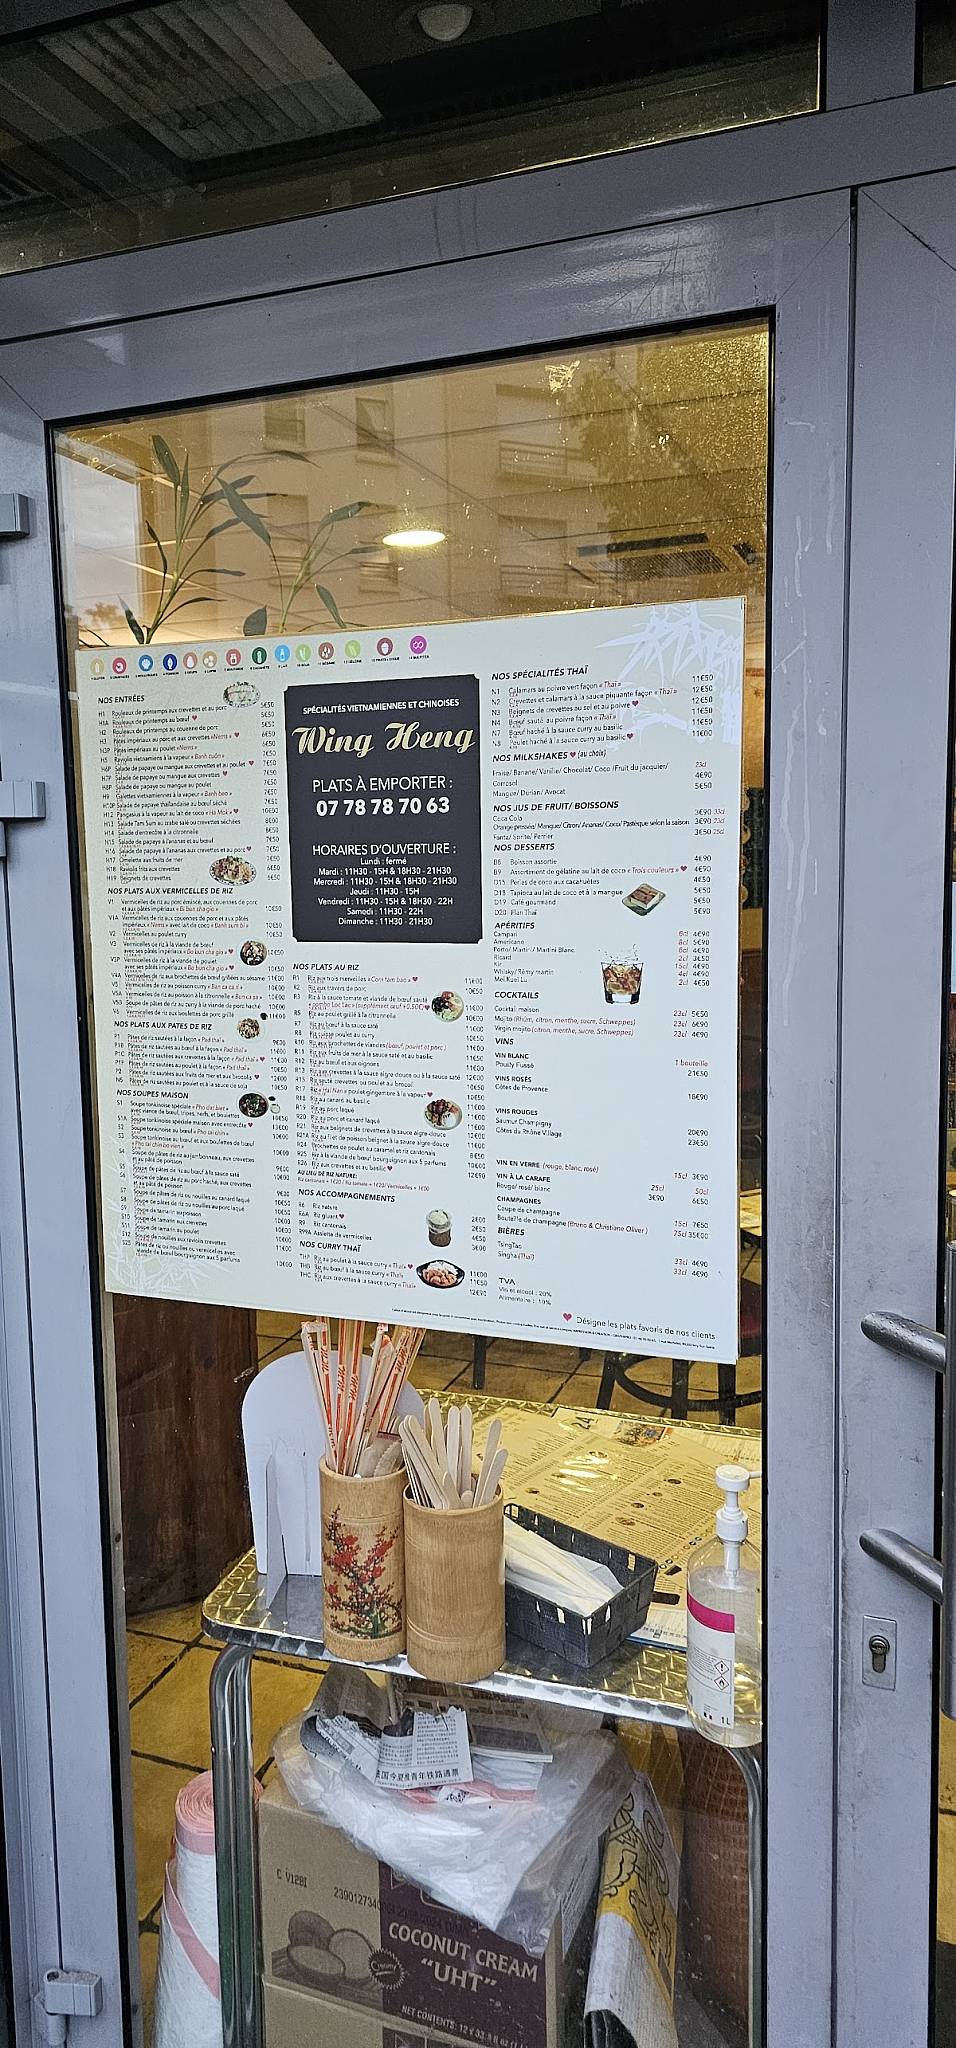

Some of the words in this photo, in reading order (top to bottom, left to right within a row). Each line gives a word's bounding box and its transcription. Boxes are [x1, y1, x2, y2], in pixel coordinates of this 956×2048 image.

[492, 672, 510, 680] NOS
[512, 668, 564, 678] SPÉCIALITÉS
[567, 665, 588, 674] THAÏ
[114, 694, 144, 702] ENTRÉES
[303, 704, 346, 714] SPÉCIALITÉS
[346, 702, 406, 711] VIETNAMIENNES
[418, 699, 459, 707] CHINOISES
[292, 725, 374, 757] Wing
[385, 722, 476, 754] Heng
[492, 754, 510, 762] NOS
[513, 752, 568, 760] MILKSHAKES
[313, 779, 352, 792] PLATS
[356, 775, 366, 791] À
[370, 776, 445, 790] EMPORTER
[316, 800, 338, 816] 07
[343, 799, 366, 815] 78
[370, 798, 393, 814] 78
[398, 798, 421, 813] 70
[426, 797, 449, 813] 63
[545, 802, 573, 810] FRUIT/
[574, 801, 618, 809] BOISSONS
[312, 844, 367, 855] HORAIRES
[370, 843, 449, 854] D'OUVERTURE
[426, 866, 451, 874] 21H30
[350, 877, 373, 885] 11H30
[318, 897, 349, 905] Vendredi
[356, 897, 378, 905] 11H30
[408, 897, 432, 905] 18H30
[408, 907, 423, 915] 22H
[316, 1190, 395, 1201] ACCOMPAGNEMENTS
[496, 1196, 541, 1204] CHAMPAGNES
[498, 1227, 524, 1235] BIÈRES
[342, 1244, 361, 1252] THAÏ
[498, 1277, 515, 1285] TVA
[576, 1316, 606, 1327] Désigne
[608, 1320, 617, 1328] les
[619, 1322, 636, 1330] plats
[638, 1323, 662, 1333] favoris
[691, 1330, 715, 1339] clients
[389, 1922, 471, 1960] COCONUT
[475, 1949, 538, 1982] CREAM
